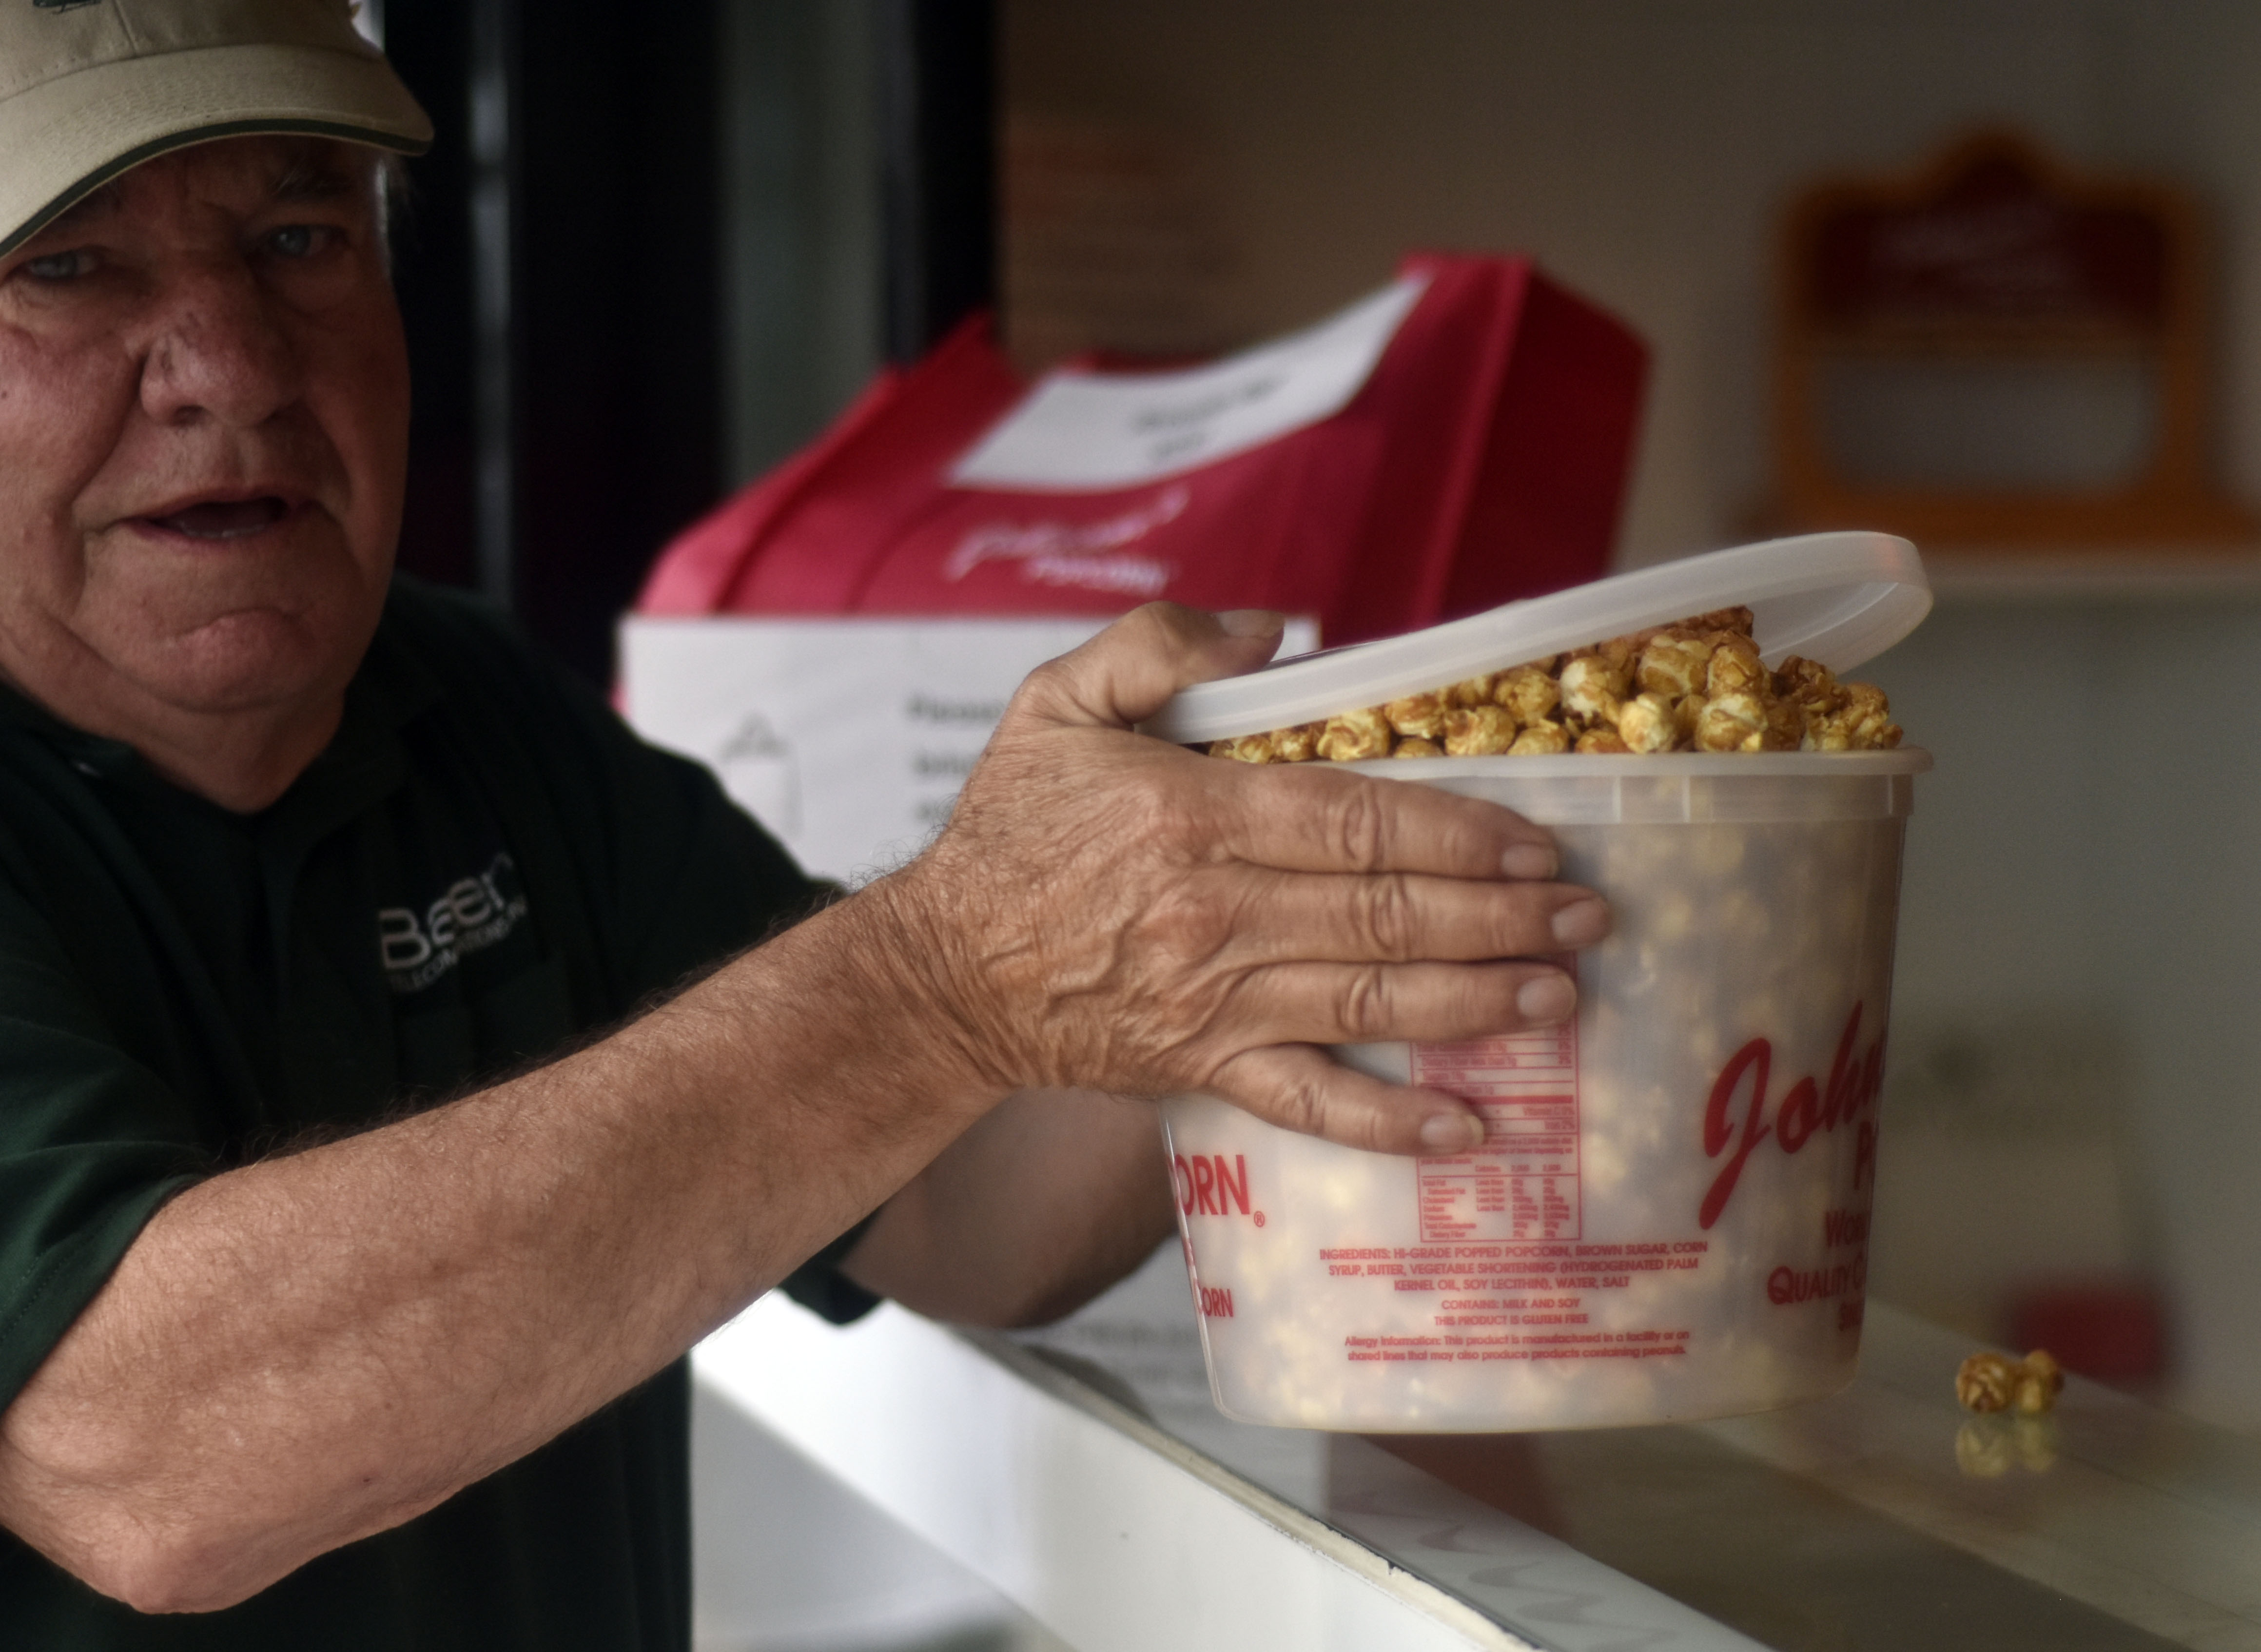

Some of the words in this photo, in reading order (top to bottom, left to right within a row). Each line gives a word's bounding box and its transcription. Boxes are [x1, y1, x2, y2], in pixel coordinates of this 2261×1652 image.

[1320, 1249, 1390, 1260] INGREDIENTS:
[1455, 1247, 1501, 1257] POPPED
[1505, 1245, 1571, 1257] POPCORN,
[1576, 1245, 1622, 1256] BROWN
[1626, 1244, 1669, 1255] SUGAR,
[1674, 1241, 1707, 1252] CORN
[1328, 1264, 1364, 1277] SYRUP,
[1367, 1264, 1406, 1276] BUTTER,
[1410, 1263, 1475, 1274] VEGETABLE
[1478, 1262, 1556, 1274] SHORTENING
[1667, 1258, 1698, 1268] PALM
[1394, 1280, 1435, 1291] KERNEL
[1438, 1280, 1460, 1291] OIL,
[1463, 1279, 1488, 1290] SOY
[1492, 1277, 1553, 1289] LECITHIN),
[1556, 1277, 1599, 1289] WATER,
[1603, 1277, 1630, 1287] SALT
[1442, 1300, 1500, 1309] CONTAINS:
[1502, 1299, 1527, 1309] MILK
[1531, 1299, 1555, 1308] AND
[1559, 1298, 1580, 1308] SOY
[1434, 1316, 1455, 1325] THIS
[1458, 1316, 1507, 1325] PRODUCT
[1510, 1315, 1520, 1325] IS
[1522, 1315, 1562, 1324] GLUTEN
[1565, 1314, 1588, 1323] FREE
[1345, 1336, 1378, 1347] Allergy
[1445, 1335, 1462, 1345] This
[1466, 1335, 1509, 1346] product
[1512, 1334, 1520, 1343] is
[1522, 1334, 1601, 1343] manufactured
[1603, 1333, 1613, 1342] in
[1626, 1331, 1660, 1342] facility
[1348, 1351, 1380, 1360] shared
[1383, 1351, 1405, 1360] lines
[1408, 1351, 1427, 1360] that
[1430, 1351, 1454, 1361] may
[1457, 1351, 1479, 1360] also
[1482, 1350, 1529, 1361] produce
[1531, 1348, 1580, 1360] products
[1582, 1347, 1640, 1359] containing
[1643, 1345, 1685, 1357] peanuts.
